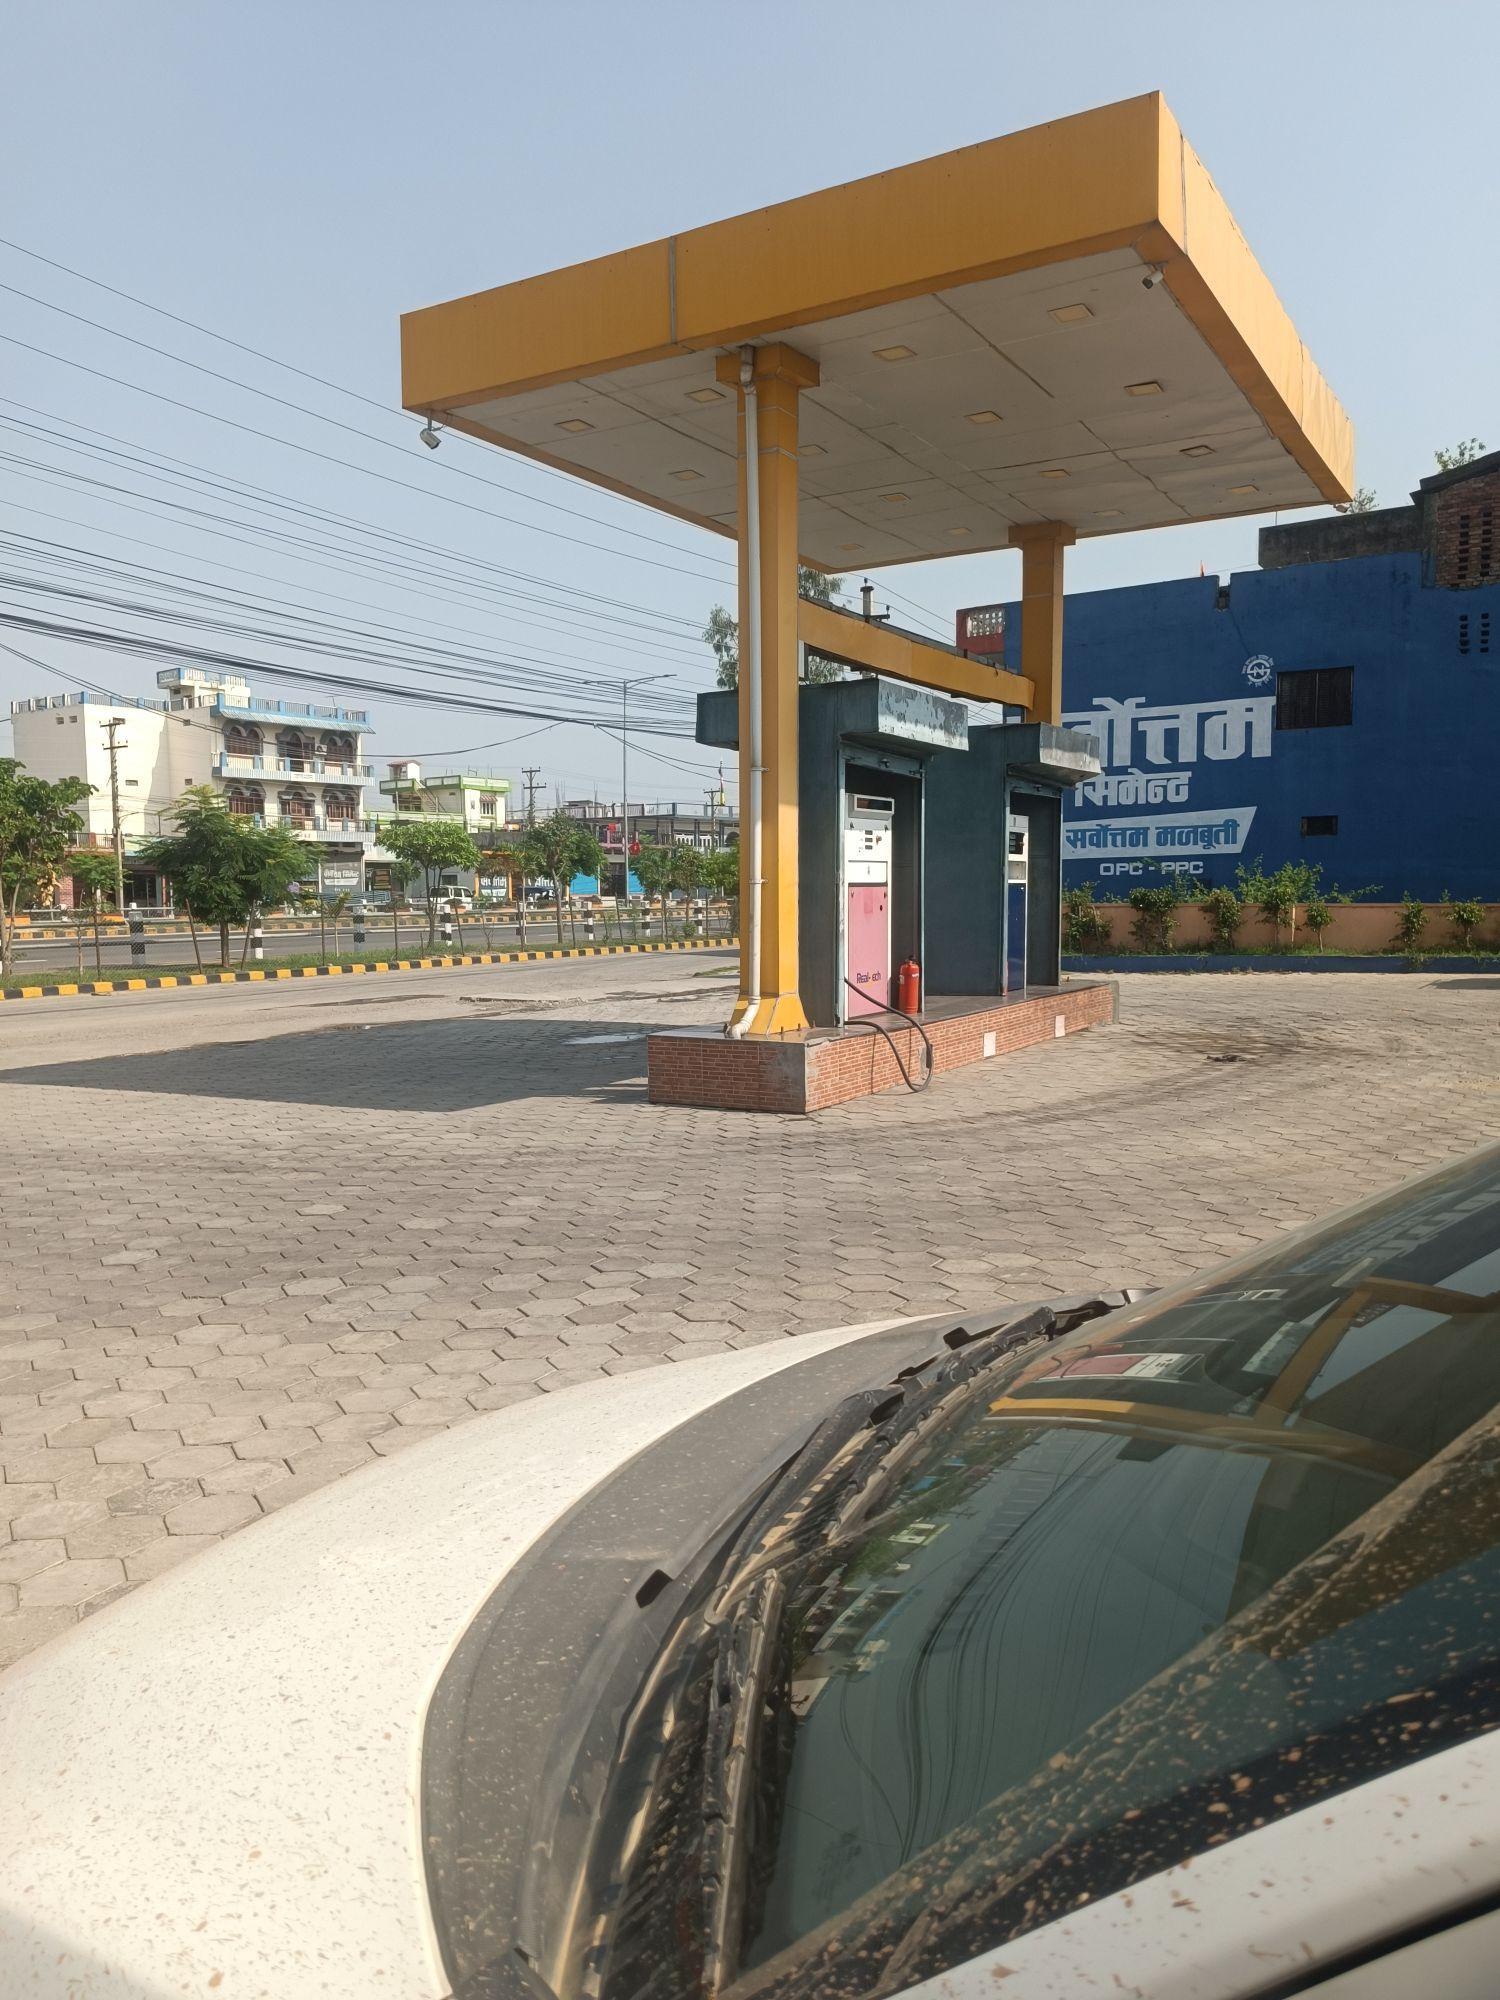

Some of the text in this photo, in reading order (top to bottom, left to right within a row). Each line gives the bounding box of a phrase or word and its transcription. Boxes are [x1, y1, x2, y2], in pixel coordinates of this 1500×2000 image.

[1066, 819, 1240, 850] सर्वोत्तम मजबूती
[1100, 863, 1143, 876] OPC
[1161, 862, 1203, 875] PPC
